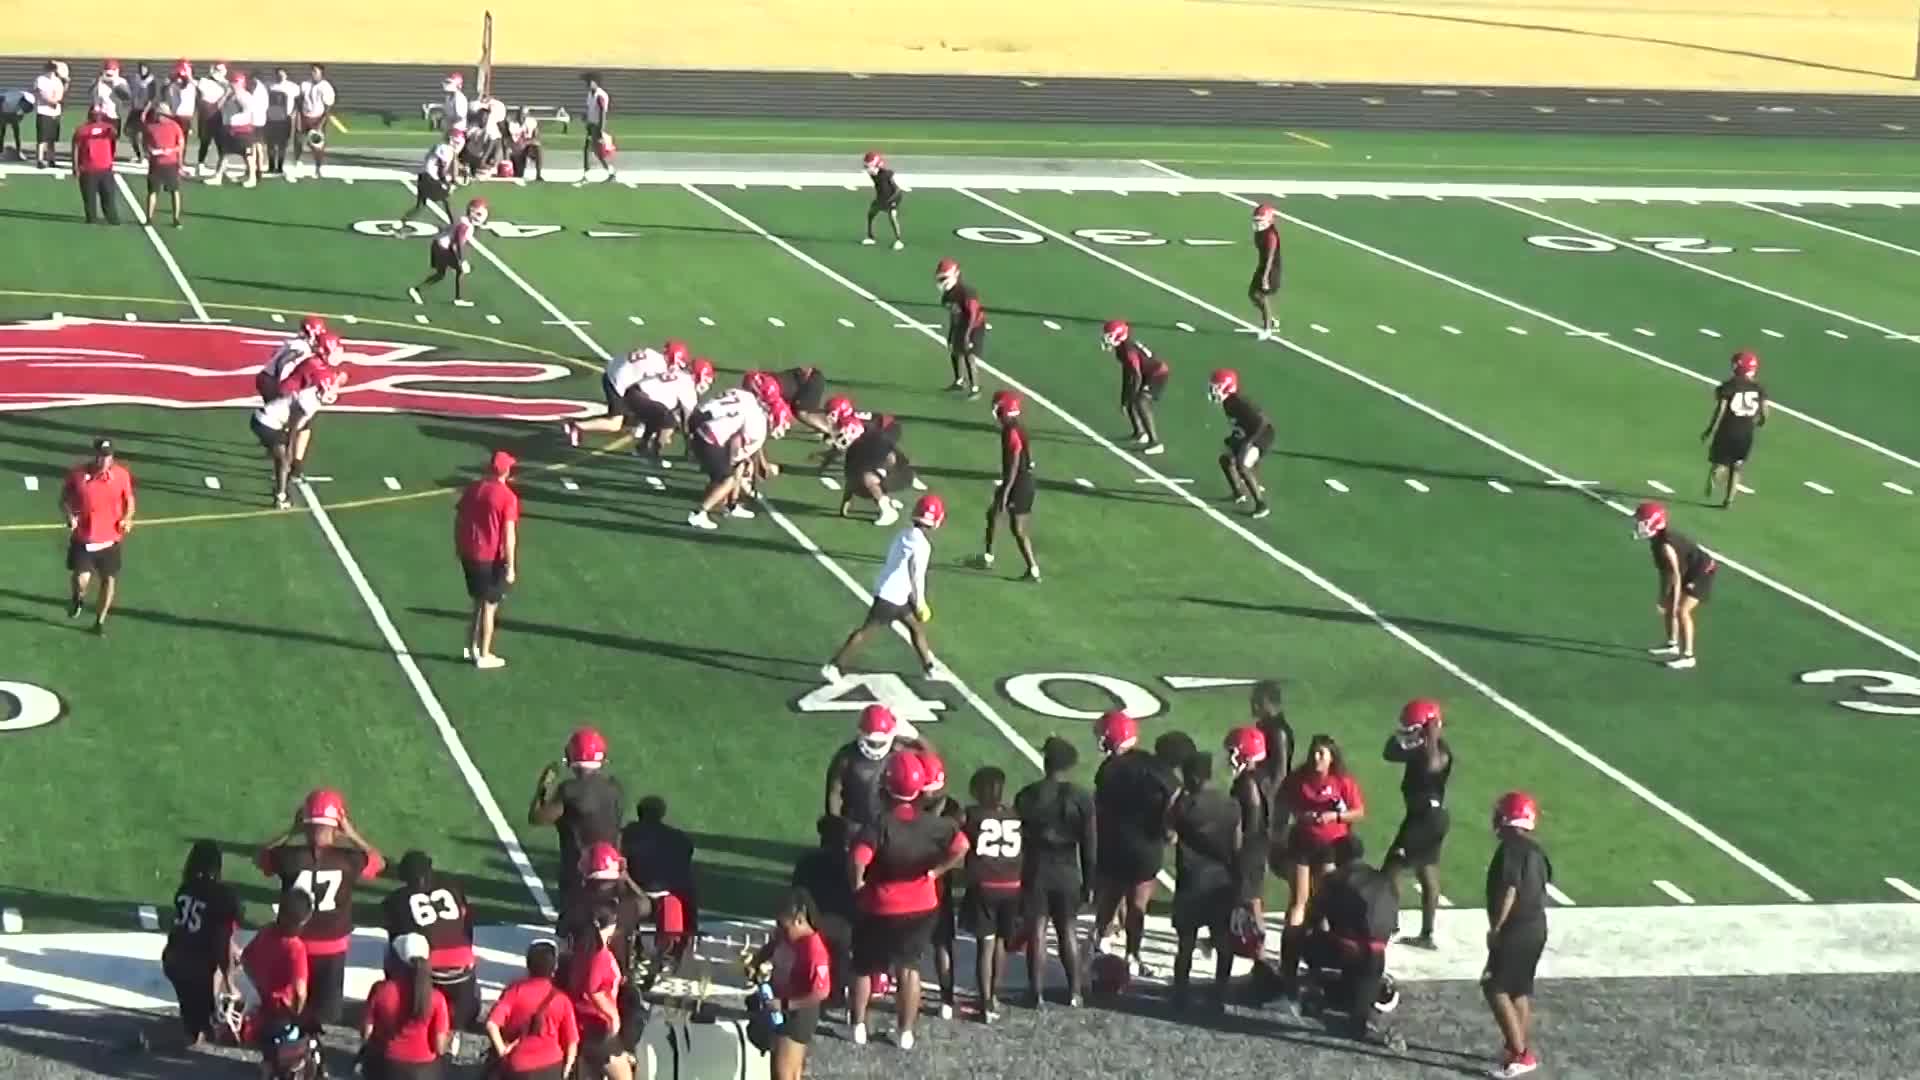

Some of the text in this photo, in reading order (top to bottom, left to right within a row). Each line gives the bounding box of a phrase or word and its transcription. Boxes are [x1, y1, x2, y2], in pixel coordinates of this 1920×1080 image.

[1730, 391, 1759, 416] 45
[976, 818, 1021, 857] 25
[174, 896, 206, 932] 35
[409, 888, 459, 926] 63
